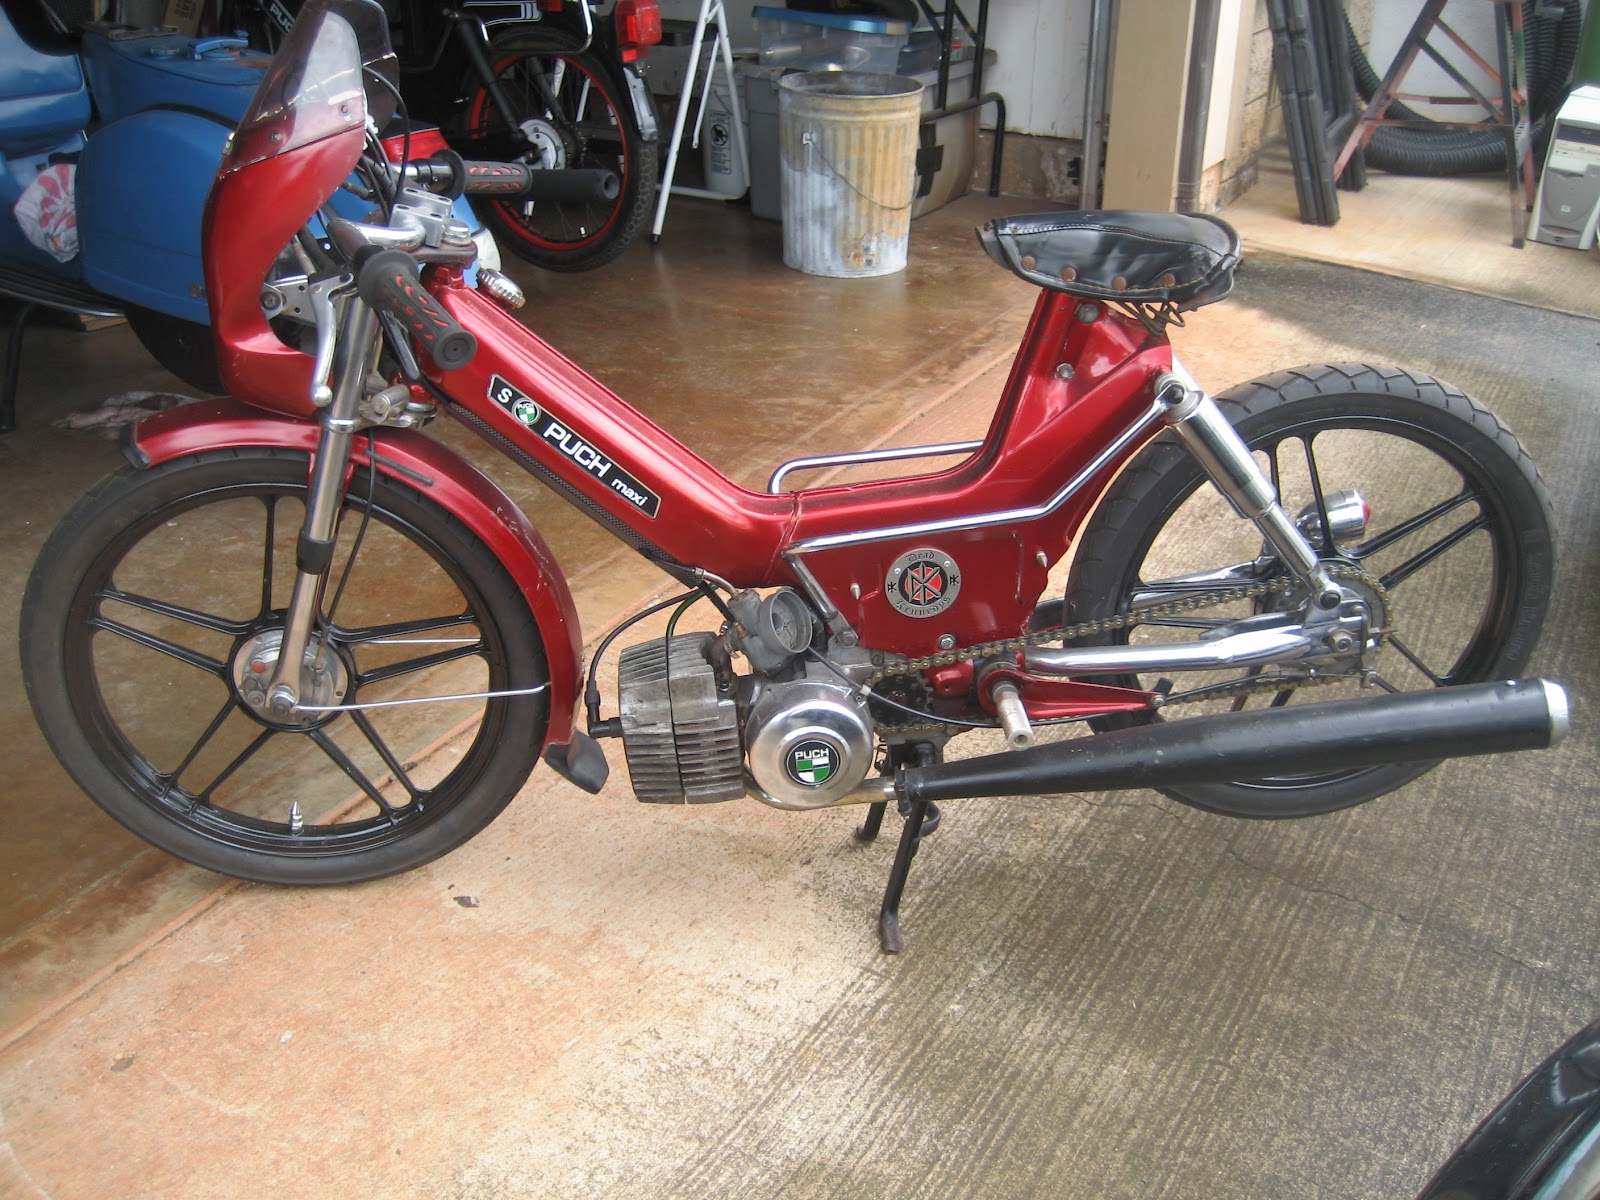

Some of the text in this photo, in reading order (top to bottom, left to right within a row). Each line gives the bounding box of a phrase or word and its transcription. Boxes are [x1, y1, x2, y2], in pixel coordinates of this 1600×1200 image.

[497, 388, 512, 403] S
[543, 422, 612, 477] PUCH
[611, 478, 648, 507] maxi
[906, 551, 935, 564] Dead
[894, 597, 951, 616] Kennedys
[794, 748, 830, 760] PUCH
